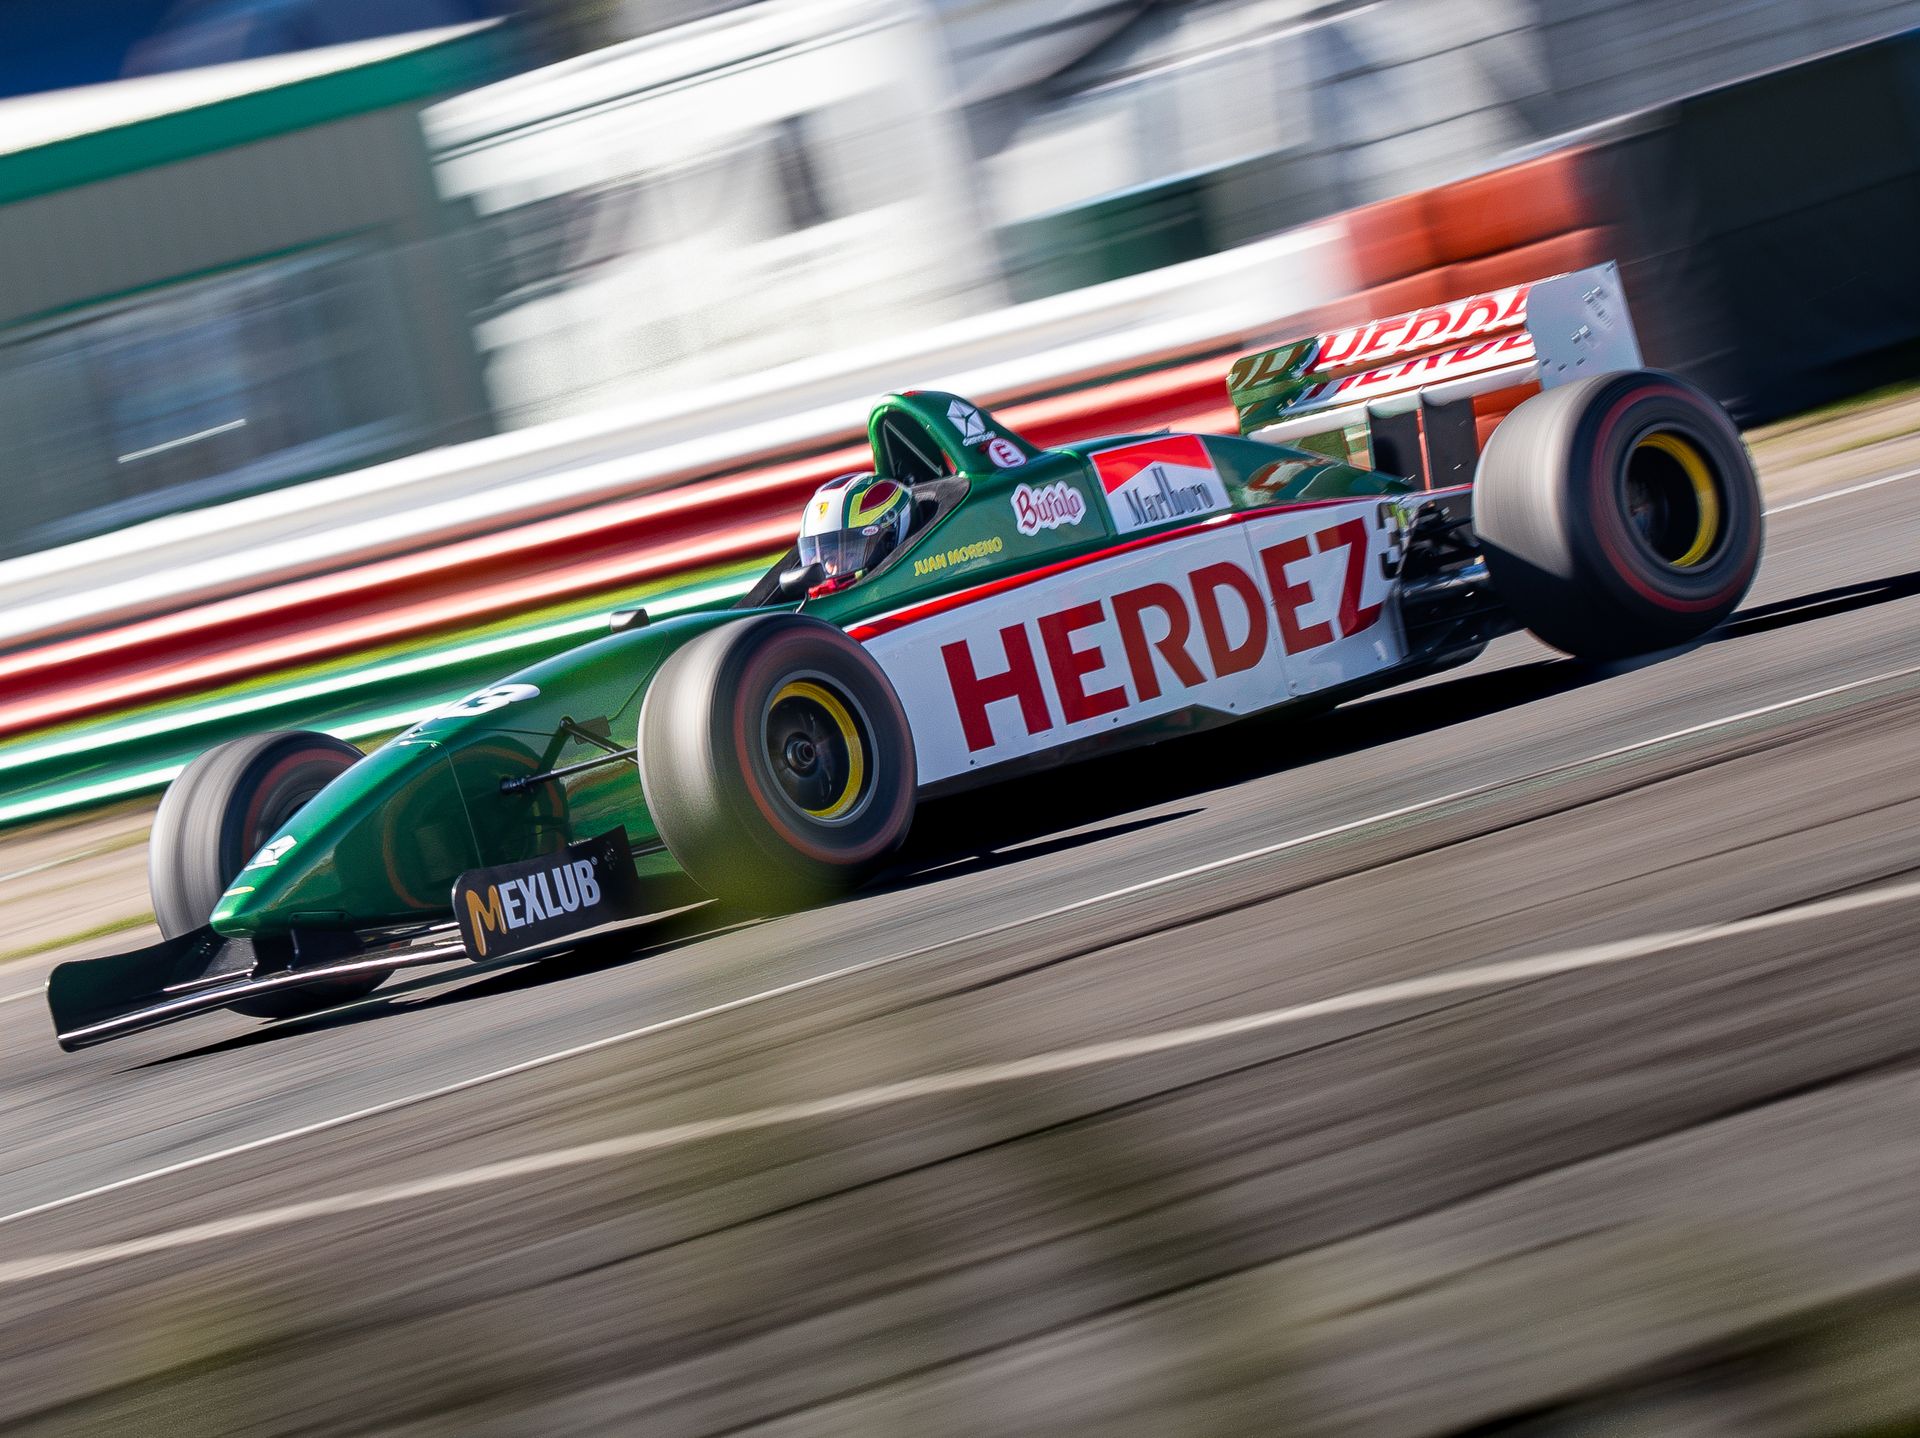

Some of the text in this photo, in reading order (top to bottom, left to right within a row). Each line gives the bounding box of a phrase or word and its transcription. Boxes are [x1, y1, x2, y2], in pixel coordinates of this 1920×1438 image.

[1122, 466, 1215, 526] Marlboro
[914, 536, 1003, 577] JUAN MORENO
[941, 516, 1383, 753] HERDEZ
